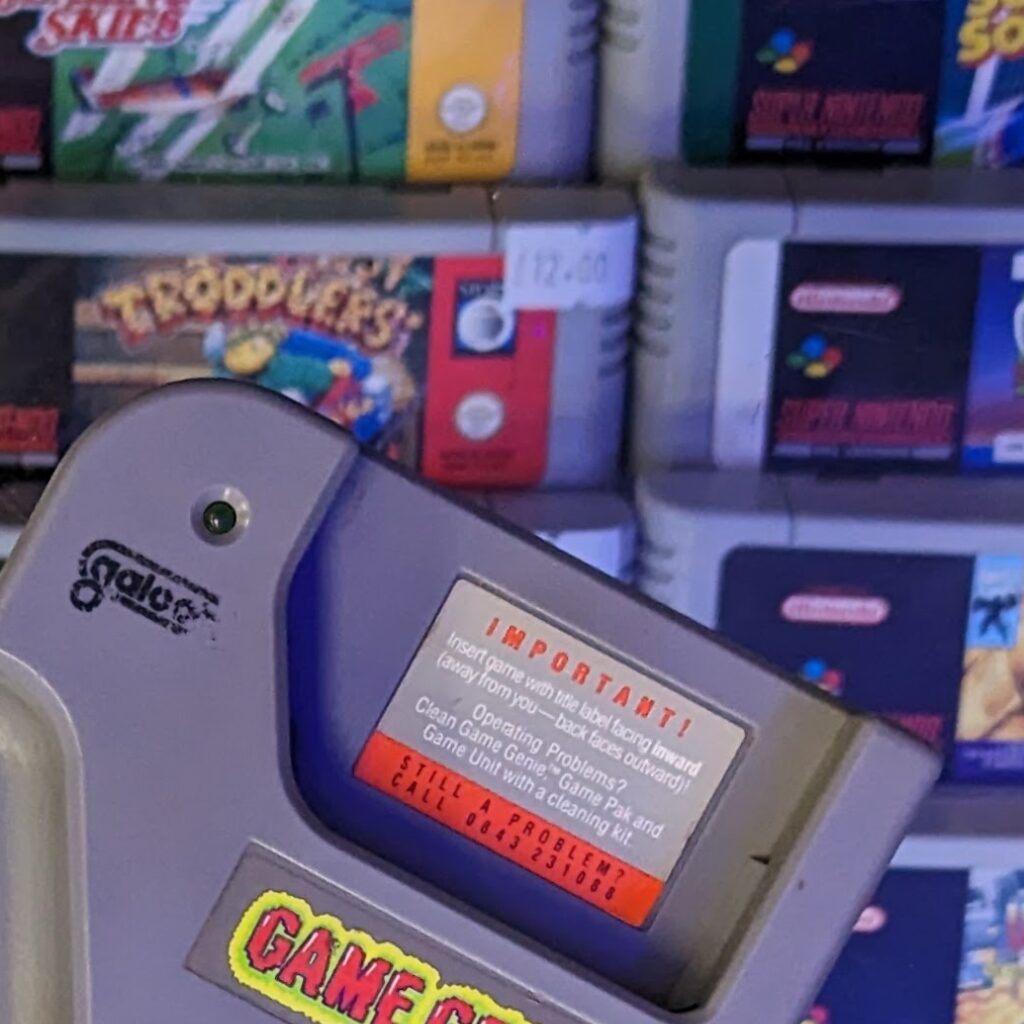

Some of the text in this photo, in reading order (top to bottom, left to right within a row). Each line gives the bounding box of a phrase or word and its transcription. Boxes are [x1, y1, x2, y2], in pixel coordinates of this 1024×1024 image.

[437, 651, 480, 684] (away
[478, 672, 513, 700] from
[588, 730, 624, 760] faces
[623, 751, 692, 793] outward)!
[448, 632, 703, 777] Insert game with title label facing inward
[486, 617, 692, 738] IMPORTANT!
[391, 772, 445, 811] CALL
[415, 696, 457, 729] Clean
[459, 719, 502, 753] Game
[558, 772, 604, 806] Game
[603, 796, 633, 824] Pak
[633, 818, 666, 839] and
[423, 723, 633, 847] Game Unit with a cleaning kit.
[472, 703, 628, 793] Operating Problems?
[400, 755, 625, 882] STILL A PROBLEM?
